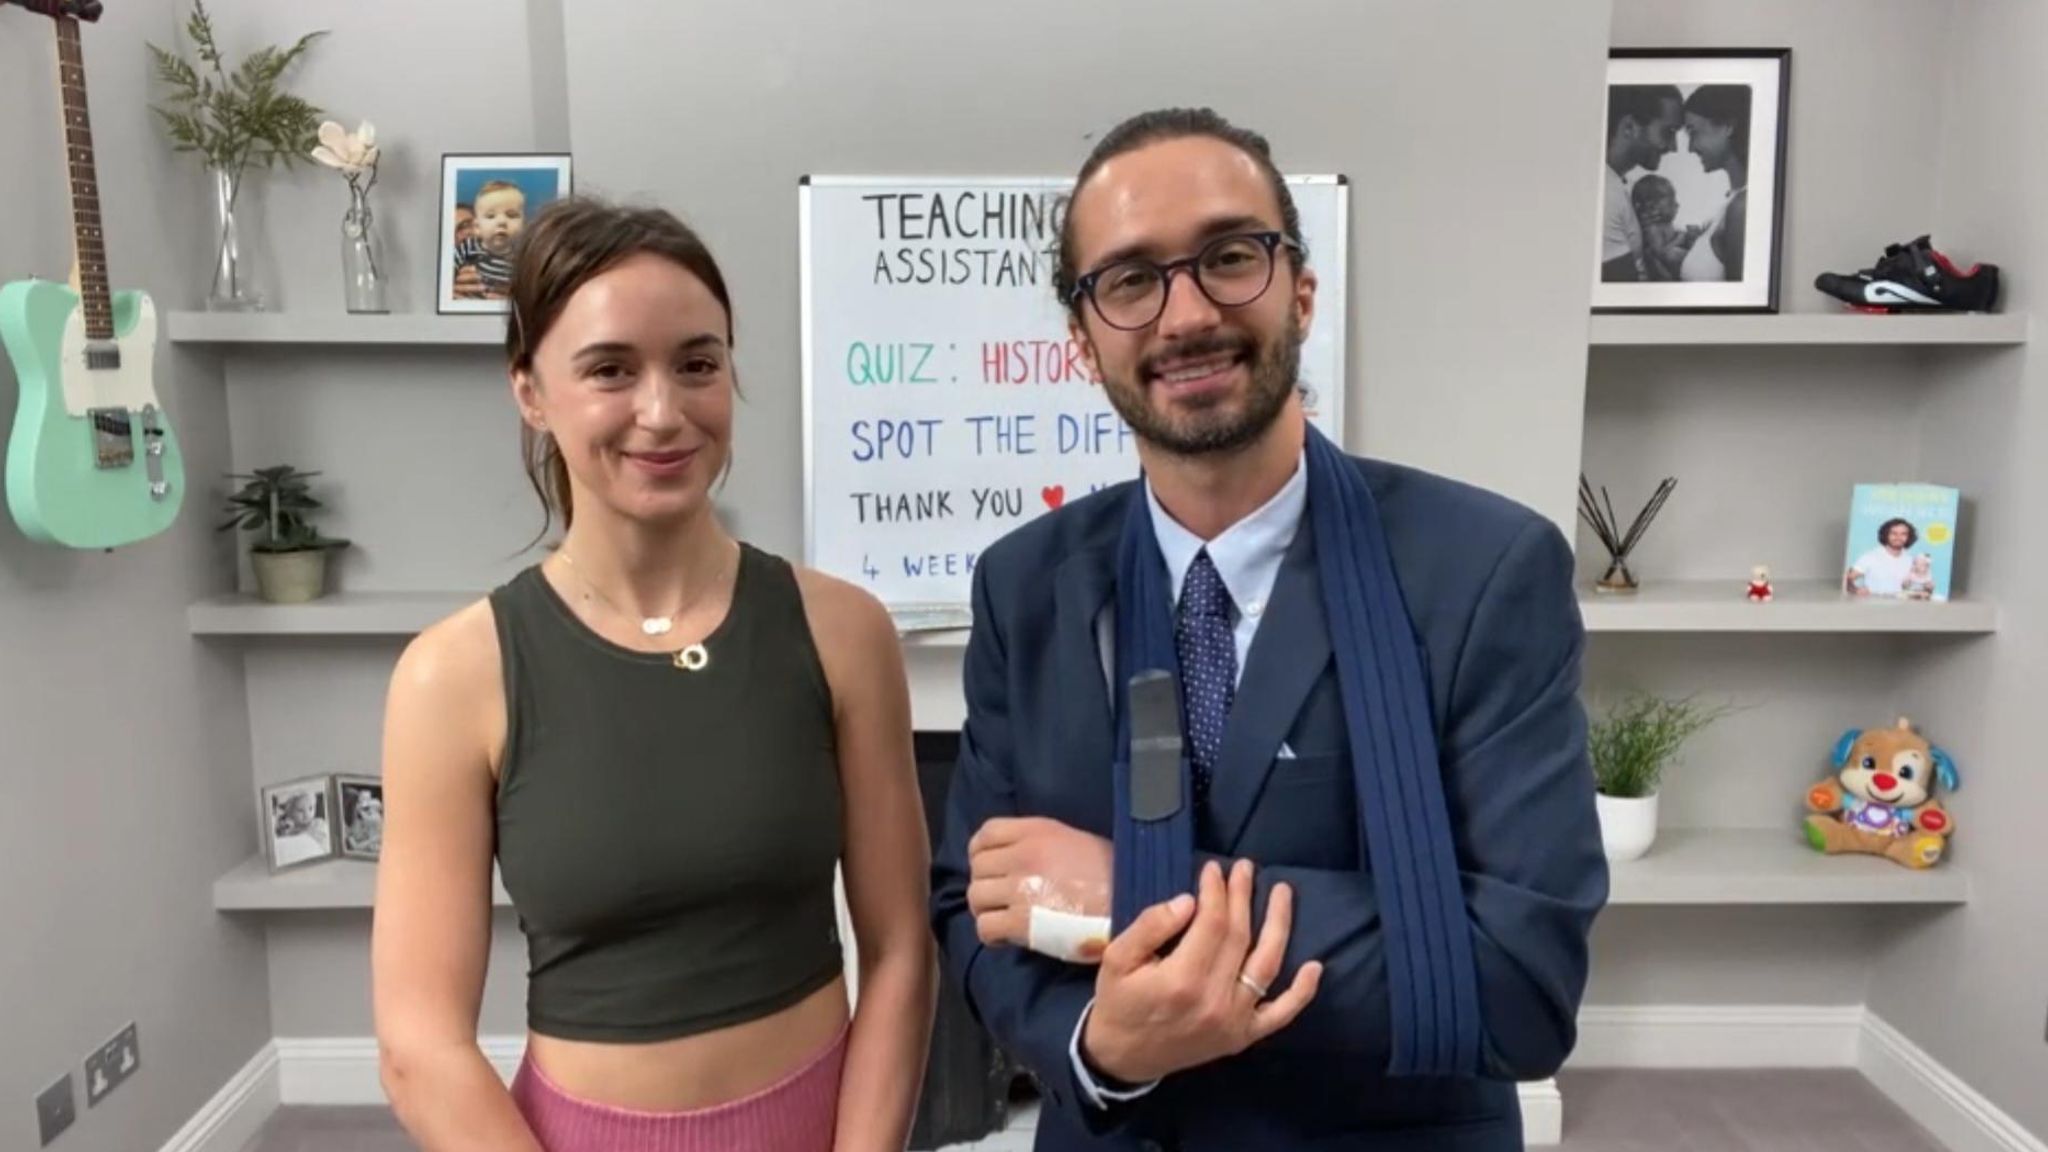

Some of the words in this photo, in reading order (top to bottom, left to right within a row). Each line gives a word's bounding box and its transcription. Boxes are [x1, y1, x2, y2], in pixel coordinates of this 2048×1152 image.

[983, 340, 1096, 386] HISTOR
[851, 419, 943, 462] SPOT
[965, 415, 1037, 455] THE
[849, 489, 954, 524] THANK
[972, 487, 1022, 520] YOU
[862, 554, 880, 580] 4
